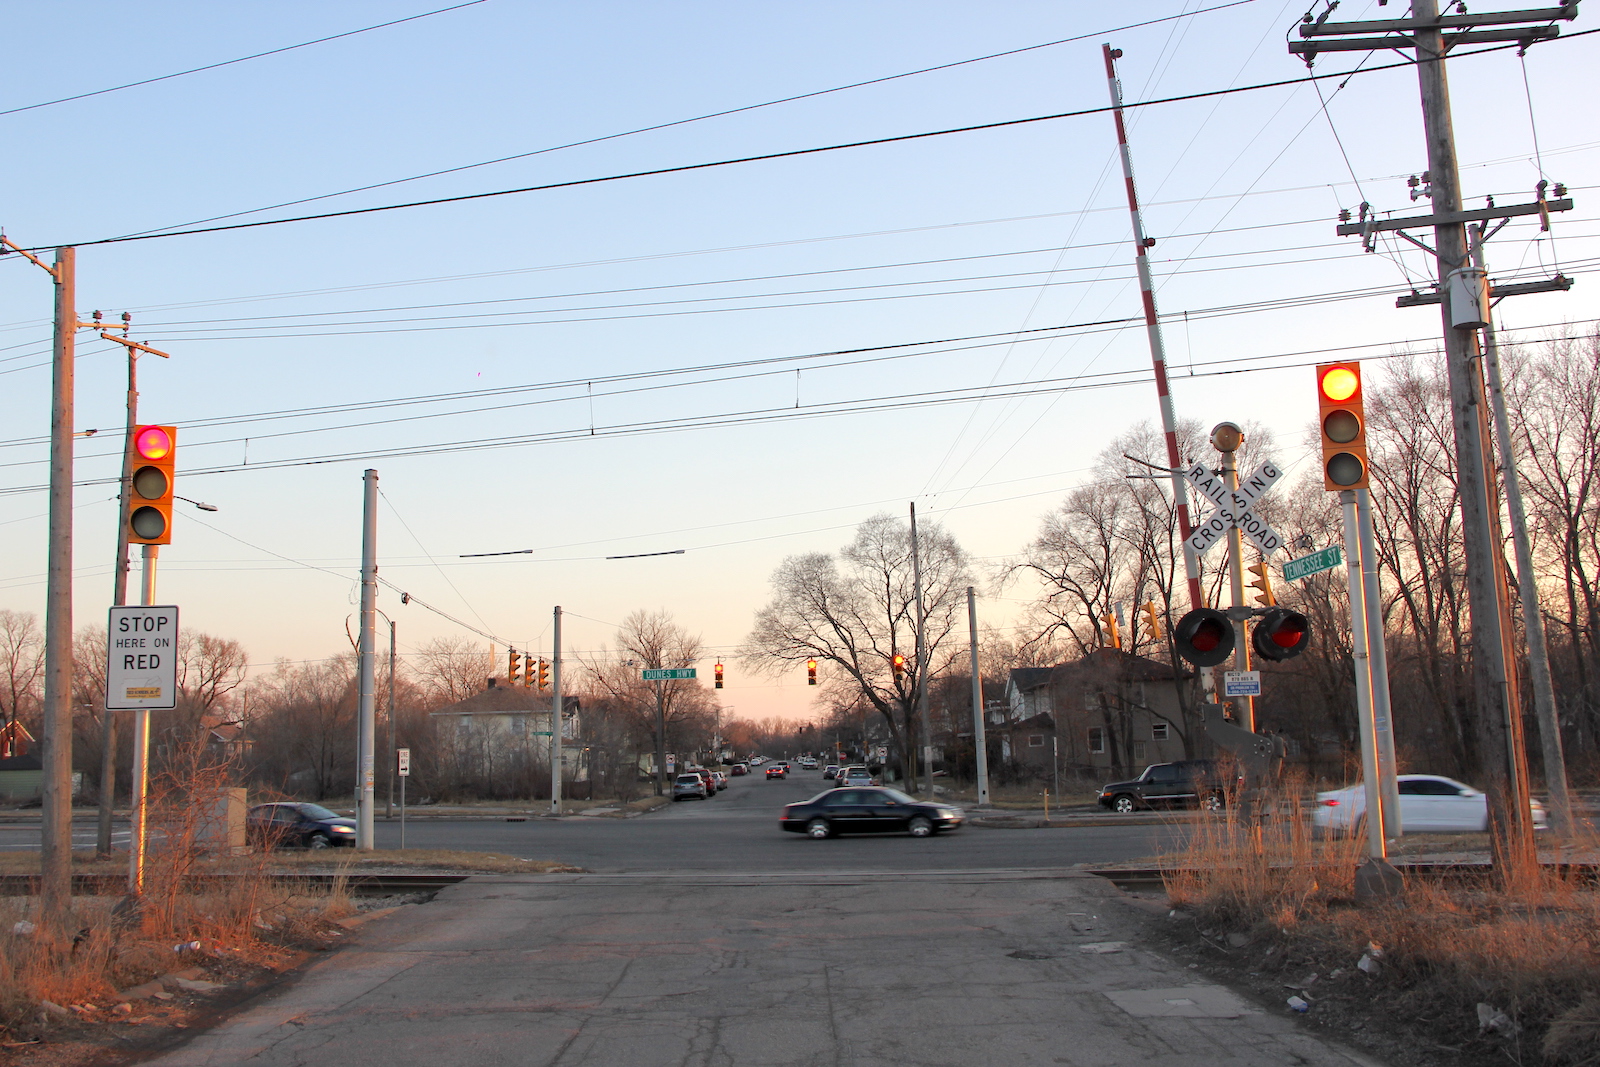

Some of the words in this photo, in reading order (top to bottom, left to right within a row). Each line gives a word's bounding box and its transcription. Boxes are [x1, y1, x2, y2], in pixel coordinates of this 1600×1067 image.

[1284, 553, 1324, 579] TENNESSEE
[1327, 548, 1337, 565] ST
[119, 616, 168, 632] STOP
[116, 638, 146, 648] HERE
[154, 638, 170, 648] ON
[124, 654, 160, 670] RED
[646, 670, 672, 679] DUNES
[676, 669, 693, 678] HWY
